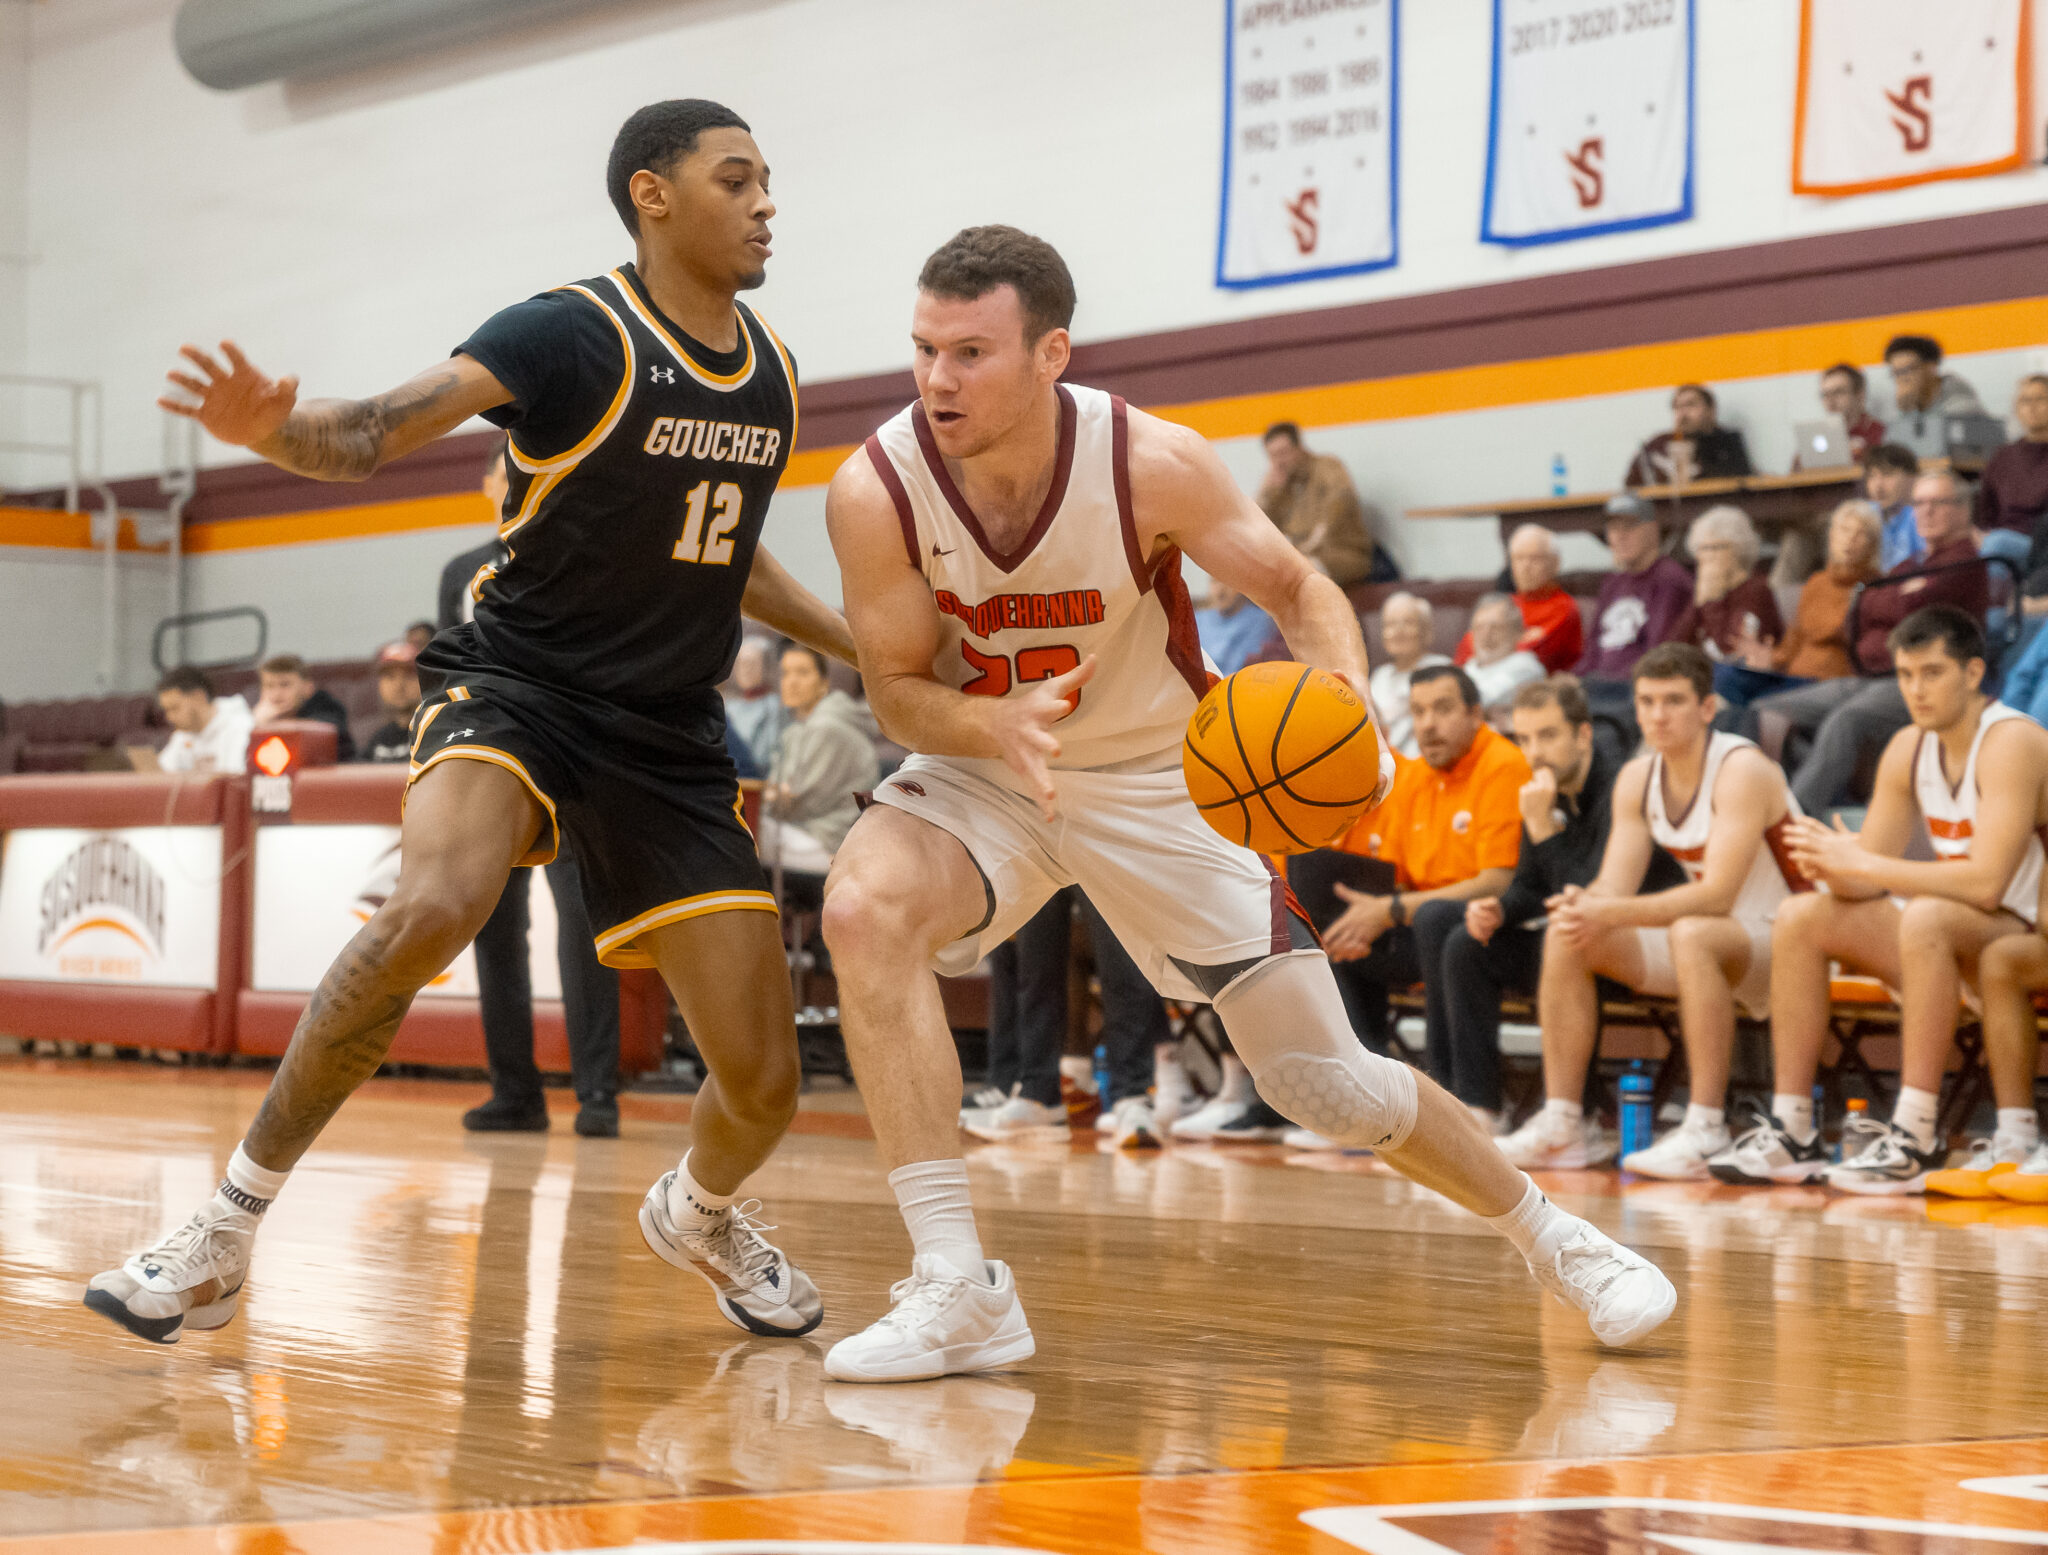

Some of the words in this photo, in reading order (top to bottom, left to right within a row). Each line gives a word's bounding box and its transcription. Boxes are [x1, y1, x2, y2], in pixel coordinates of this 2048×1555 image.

[1510, 16, 1560, 56] 2017
[1566, 7, 1615, 45] 2020
[643, 416, 781, 467] GOUCHER
[671, 480, 743, 565] 12
[934, 588, 1106, 640] SUSQUEHANNA
